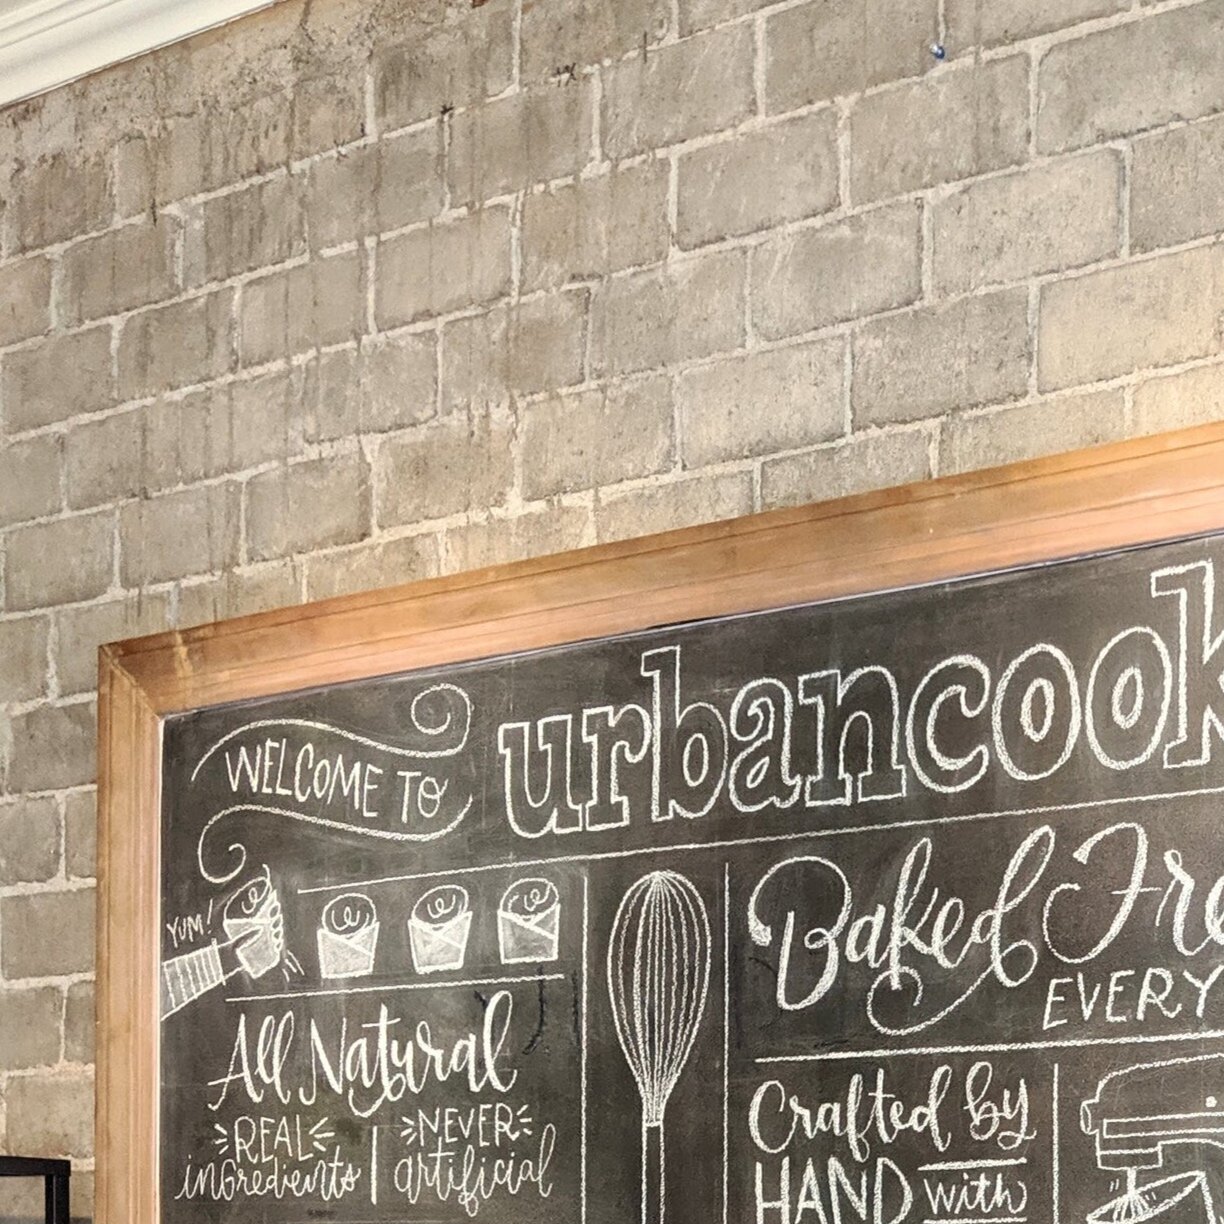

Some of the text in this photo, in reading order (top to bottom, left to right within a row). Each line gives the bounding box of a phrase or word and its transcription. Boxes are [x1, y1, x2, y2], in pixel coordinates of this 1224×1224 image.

[225, 737, 450, 823] WELCOME TO
[165, 899, 214, 947] YUM!
[748, 825, 1056, 1036] Baked
[1043, 963, 1224, 1030] EVERY
[207, 990, 518, 1118] All Natural
[234, 1113, 314, 1164] REAL
[418, 1103, 521, 1148] NEVER
[748, 1061, 1037, 1162] Crafted by
[394, 1124, 556, 1217] artificial
[923, 1173, 1027, 1215] with
